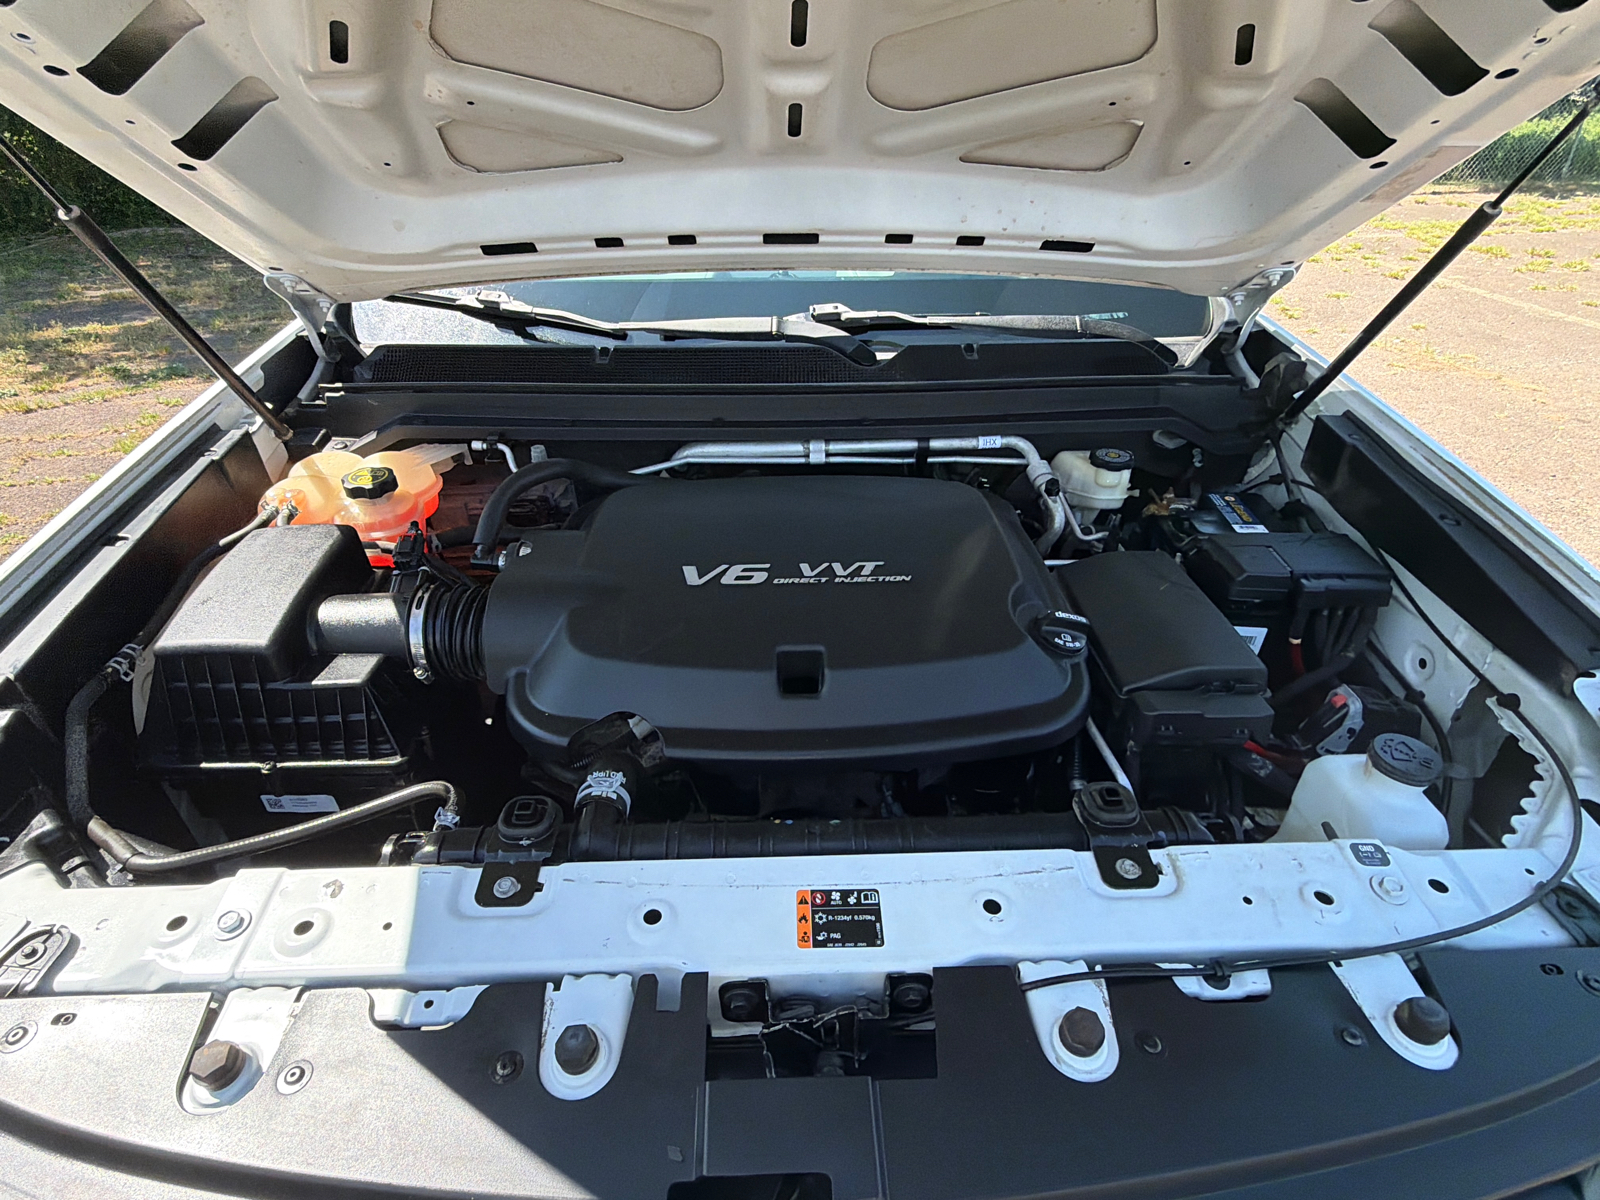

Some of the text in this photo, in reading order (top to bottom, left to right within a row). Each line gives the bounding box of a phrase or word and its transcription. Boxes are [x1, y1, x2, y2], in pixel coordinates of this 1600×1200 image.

[682, 561, 885, 586] V6 VVT
[834, 575, 912, 583] INJECTION
[1054, 611, 1087, 623] dexos
